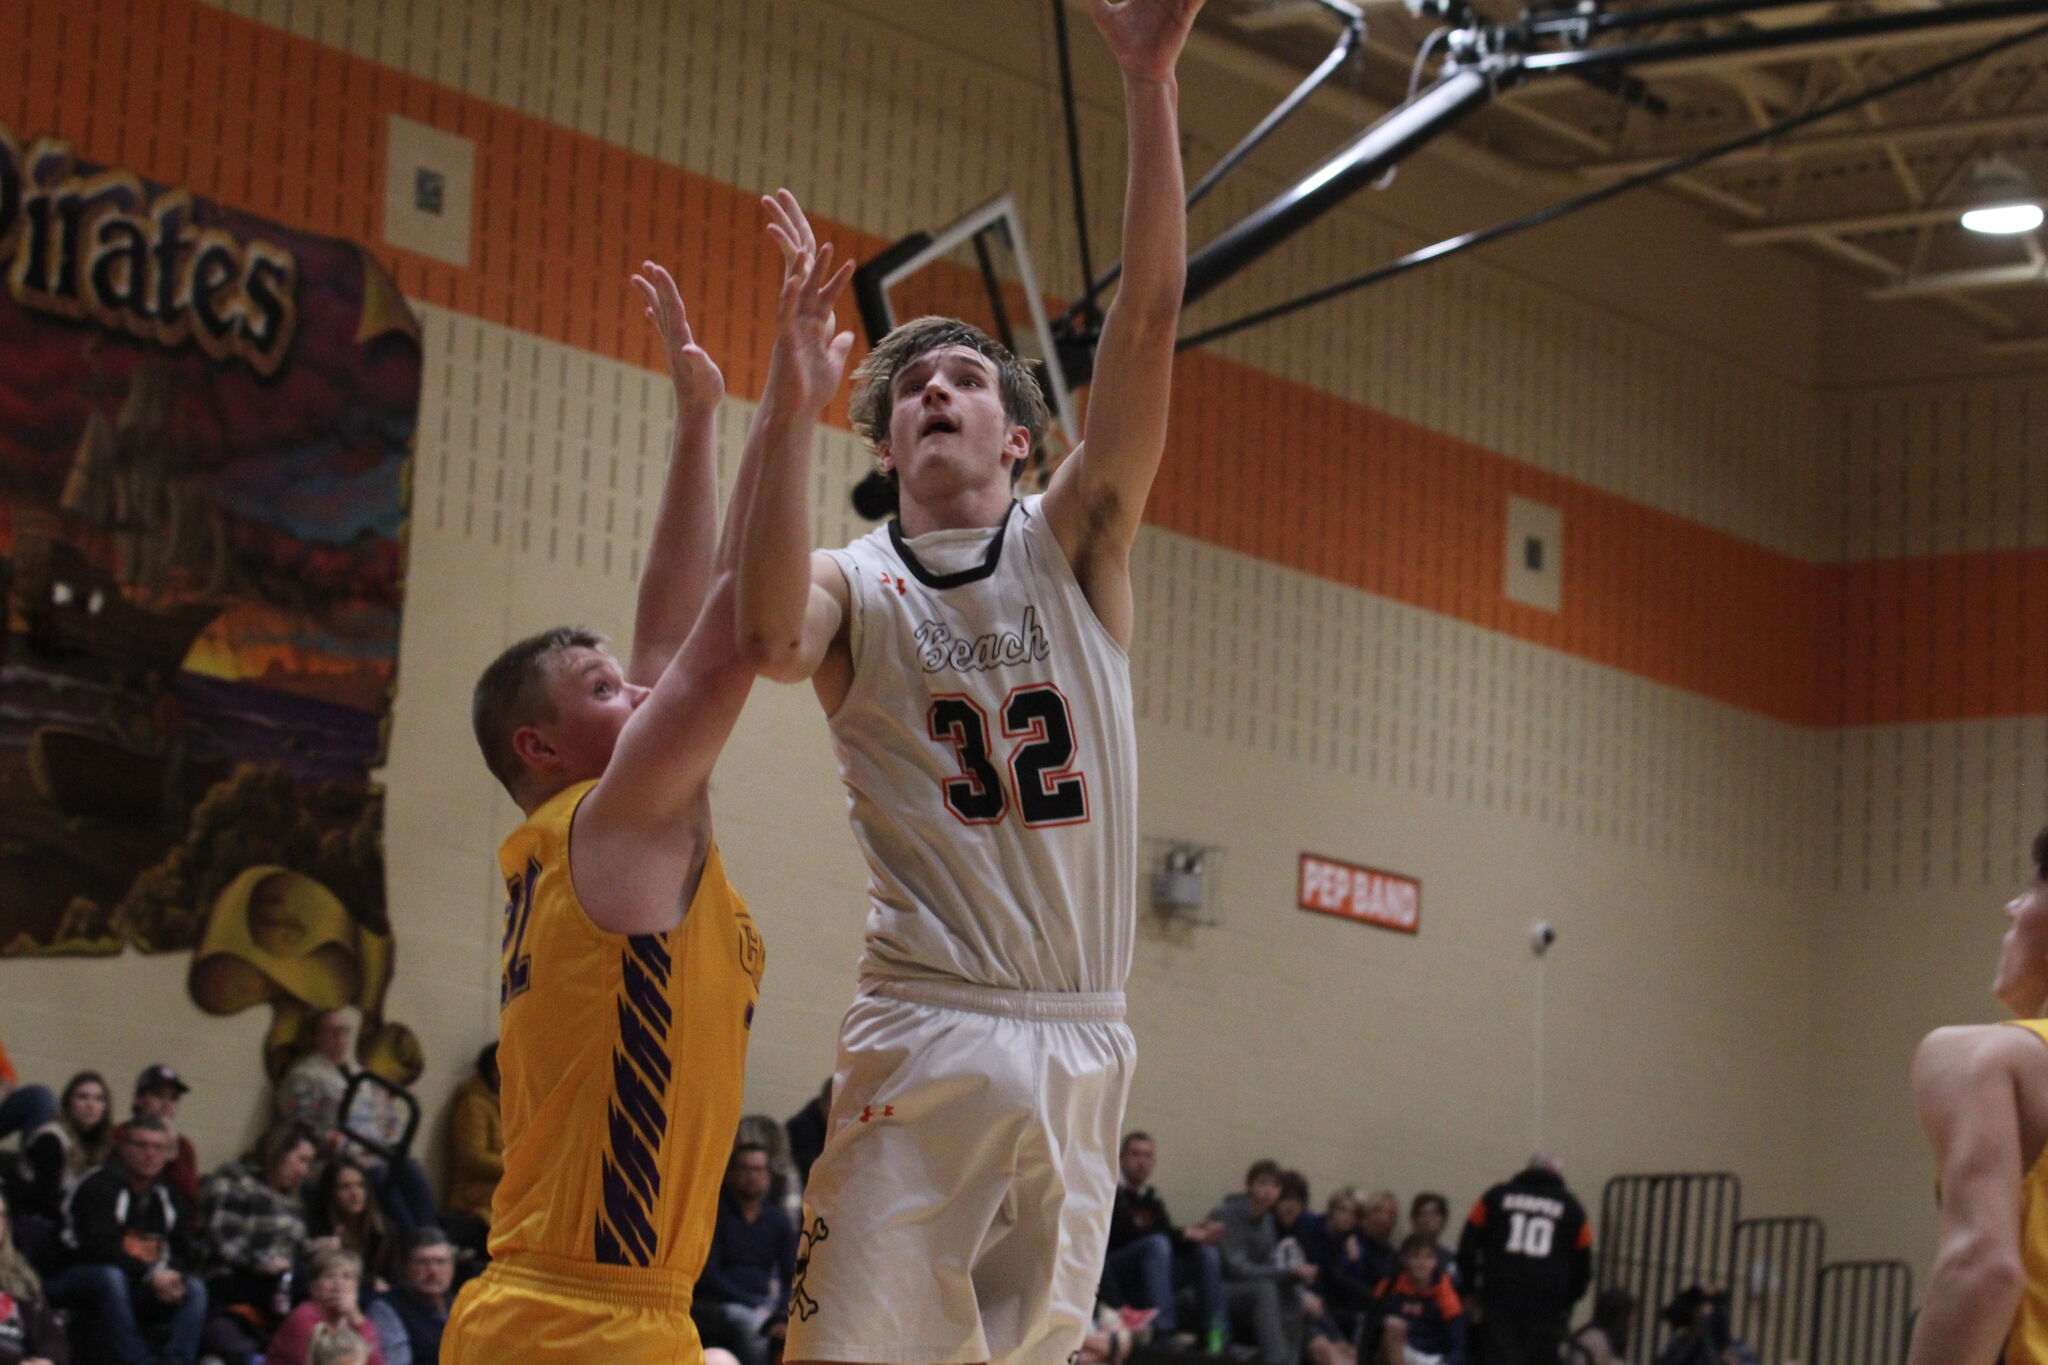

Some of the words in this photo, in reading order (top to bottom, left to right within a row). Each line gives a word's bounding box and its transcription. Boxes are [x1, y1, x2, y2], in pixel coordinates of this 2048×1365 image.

[914, 605, 1050, 674] Beach
[926, 681, 1091, 829] 32
[1303, 860, 1351, 908] PEP
[1354, 869, 1417, 926] BAND
[1505, 1213, 1554, 1258] 10
